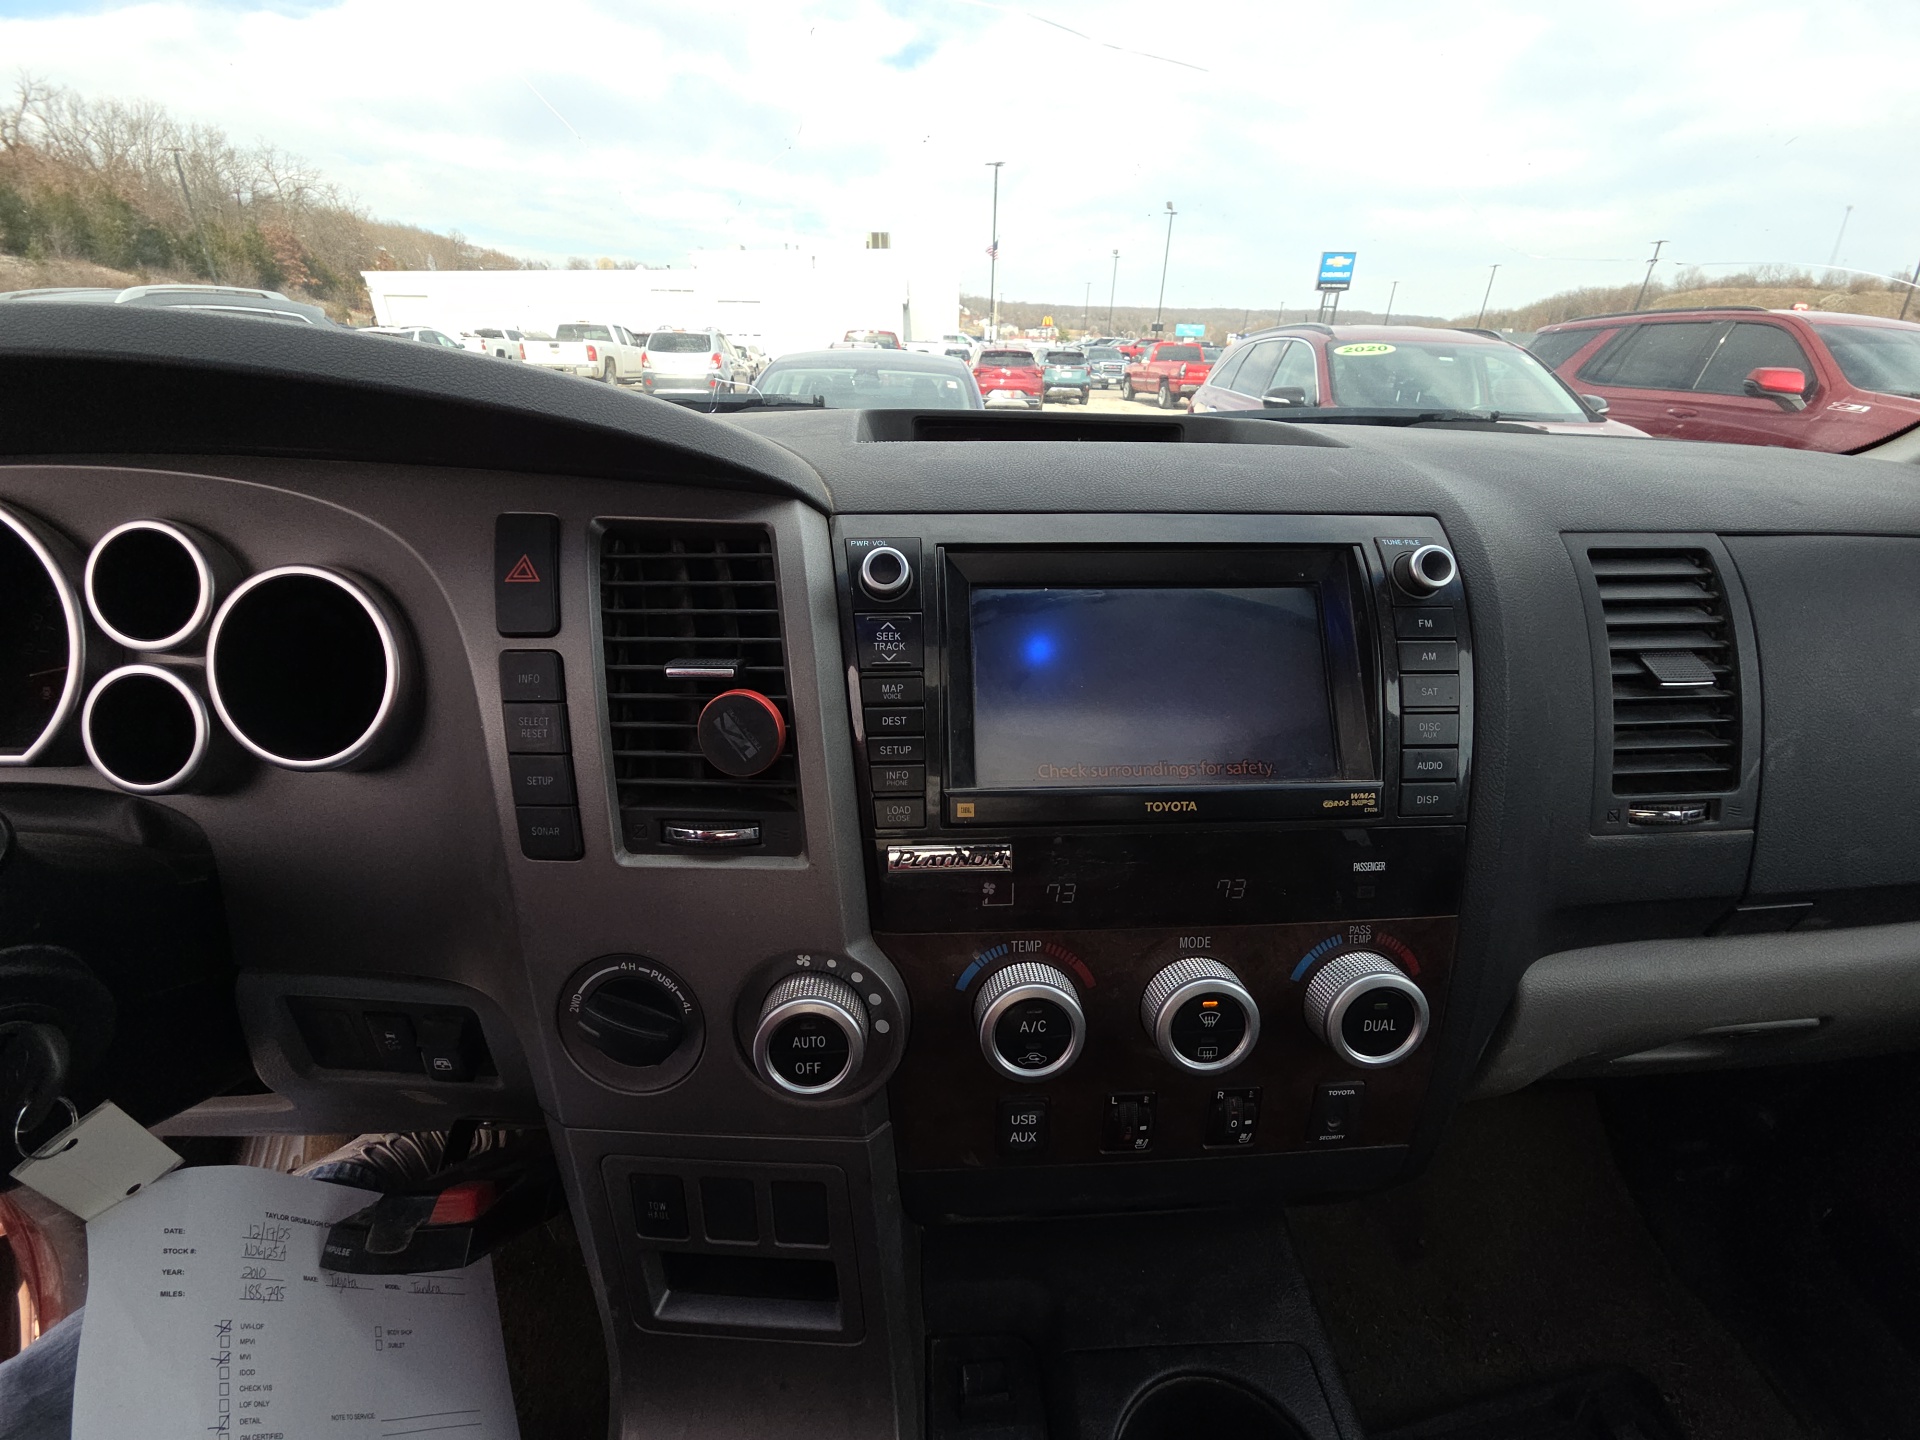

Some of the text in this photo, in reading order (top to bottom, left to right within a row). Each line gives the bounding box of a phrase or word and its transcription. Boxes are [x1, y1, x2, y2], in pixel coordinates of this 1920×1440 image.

[1343, 345, 1388, 353] 2020
[1418, 619, 1433, 628] FM
[876, 632, 901, 641] SEEK
[873, 642, 906, 651] TRACK
[1421, 652, 1437, 661] AM
[518, 674, 540, 684] INFO
[881, 684, 904, 693] MAP
[1421, 687, 1438, 696] SAT
[518, 717, 550, 726] SELECT
[882, 716, 907, 726] DEST
[1419, 722, 1441, 731] DISC
[521, 729, 548, 738] RESET
[880, 745, 912, 755] SETUP
[1038, 759, 1277, 780] Check surroundings for safety.
[1417, 761, 1443, 770] AUDIO
[886, 770, 909, 780] INFO
[527, 776, 554, 786] SETUP
[1416, 795, 1439, 804] DISP
[886, 806, 912, 815] LOAD
[1145, 801, 1198, 812] TOYOTA
[532, 826, 560, 836] SONAR
[1353, 862, 1386, 872] PASSENGER
[1047, 883, 1077, 904] 73
[1216, 878, 1246, 899] 73
[1348, 925, 1372, 935] PASS
[1178, 936, 1212, 950] MODE
[1348, 934, 1372, 944] TEMP
[1010, 940, 1042, 953] TEMP
[568, 962, 693, 1015] 2WD 4H PUSH 4L
[1020, 1020, 1047, 1034] A/C
[1362, 1018, 1396, 1033] DUAL
[792, 1036, 826, 1048] AUTO
[795, 1062, 822, 1075] OFF
[1111, 1096, 1118, 1105] L
[1217, 1091, 1224, 1100] R
[1010, 1114, 1037, 1126] USB
[1010, 1131, 1037, 1144] AUX
[648, 1201, 668, 1210] TOW
[265, 1212, 290, 1221] TAYLOR
[648, 1210, 670, 1220] HAUL
[242, 1266, 267, 1279] 2010
[239, 1400, 252, 1408] LOF
